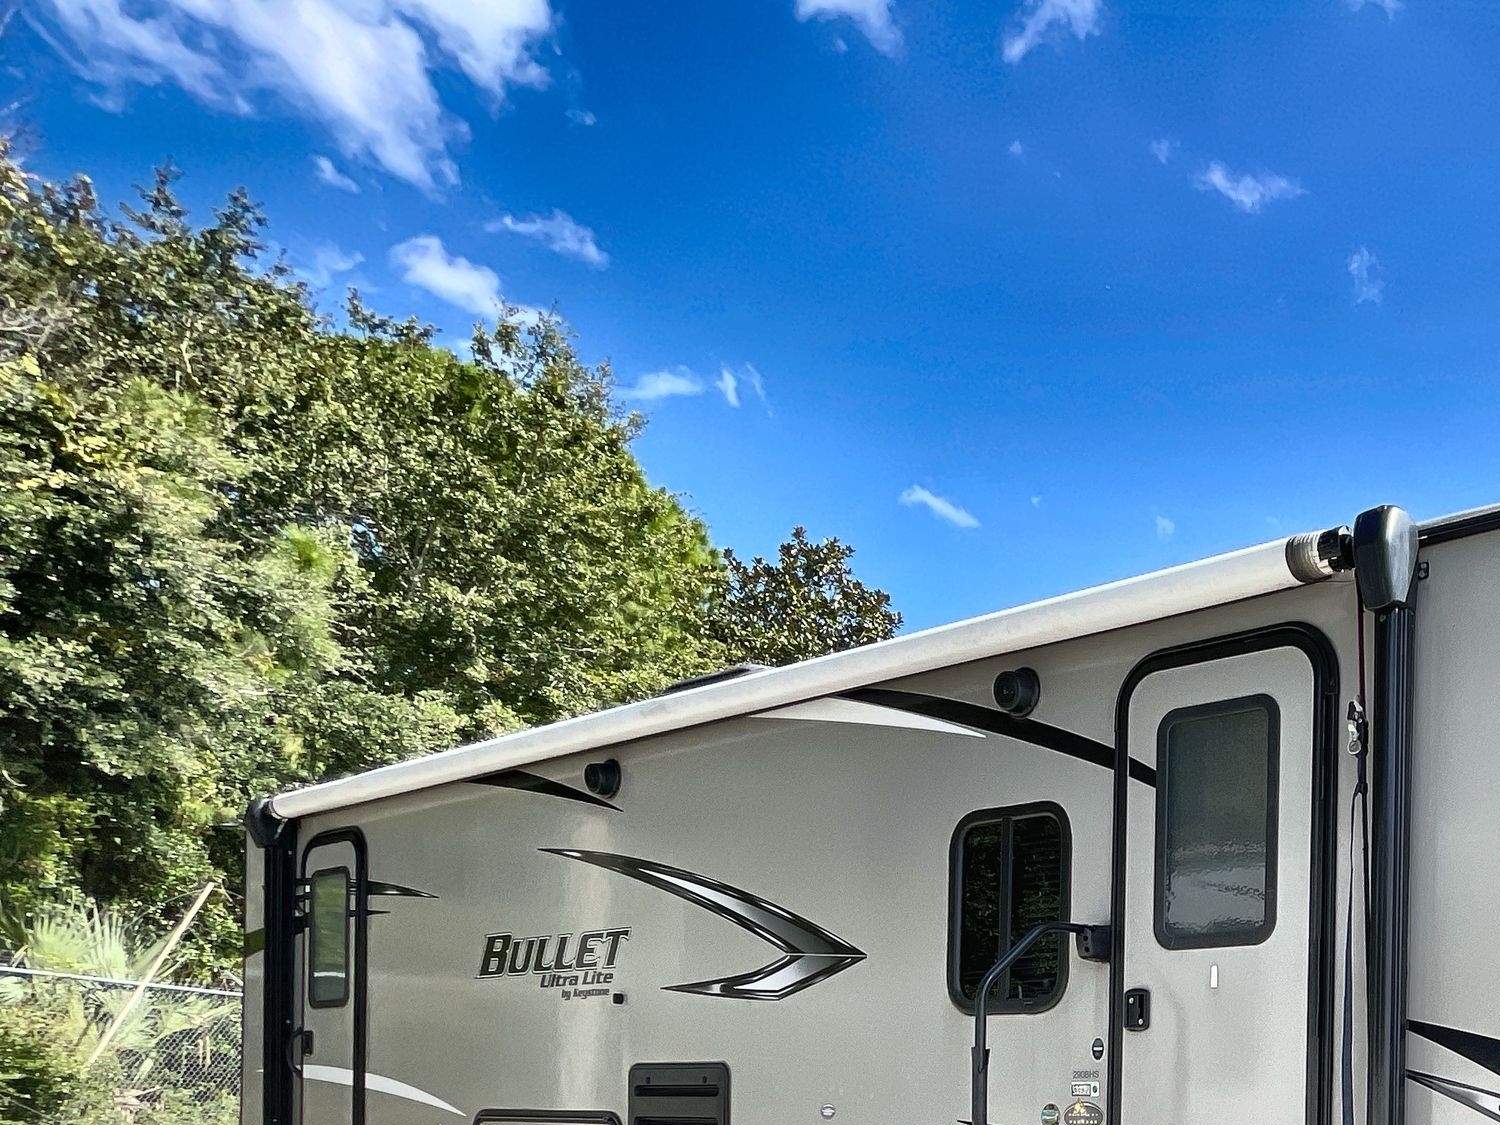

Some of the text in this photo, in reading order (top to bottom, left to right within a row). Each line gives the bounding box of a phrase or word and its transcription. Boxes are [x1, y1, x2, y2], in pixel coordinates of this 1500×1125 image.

[476, 926, 632, 979] BULLET
[540, 971, 614, 988] Ultra Lite
[561, 989, 571, 1000] by
